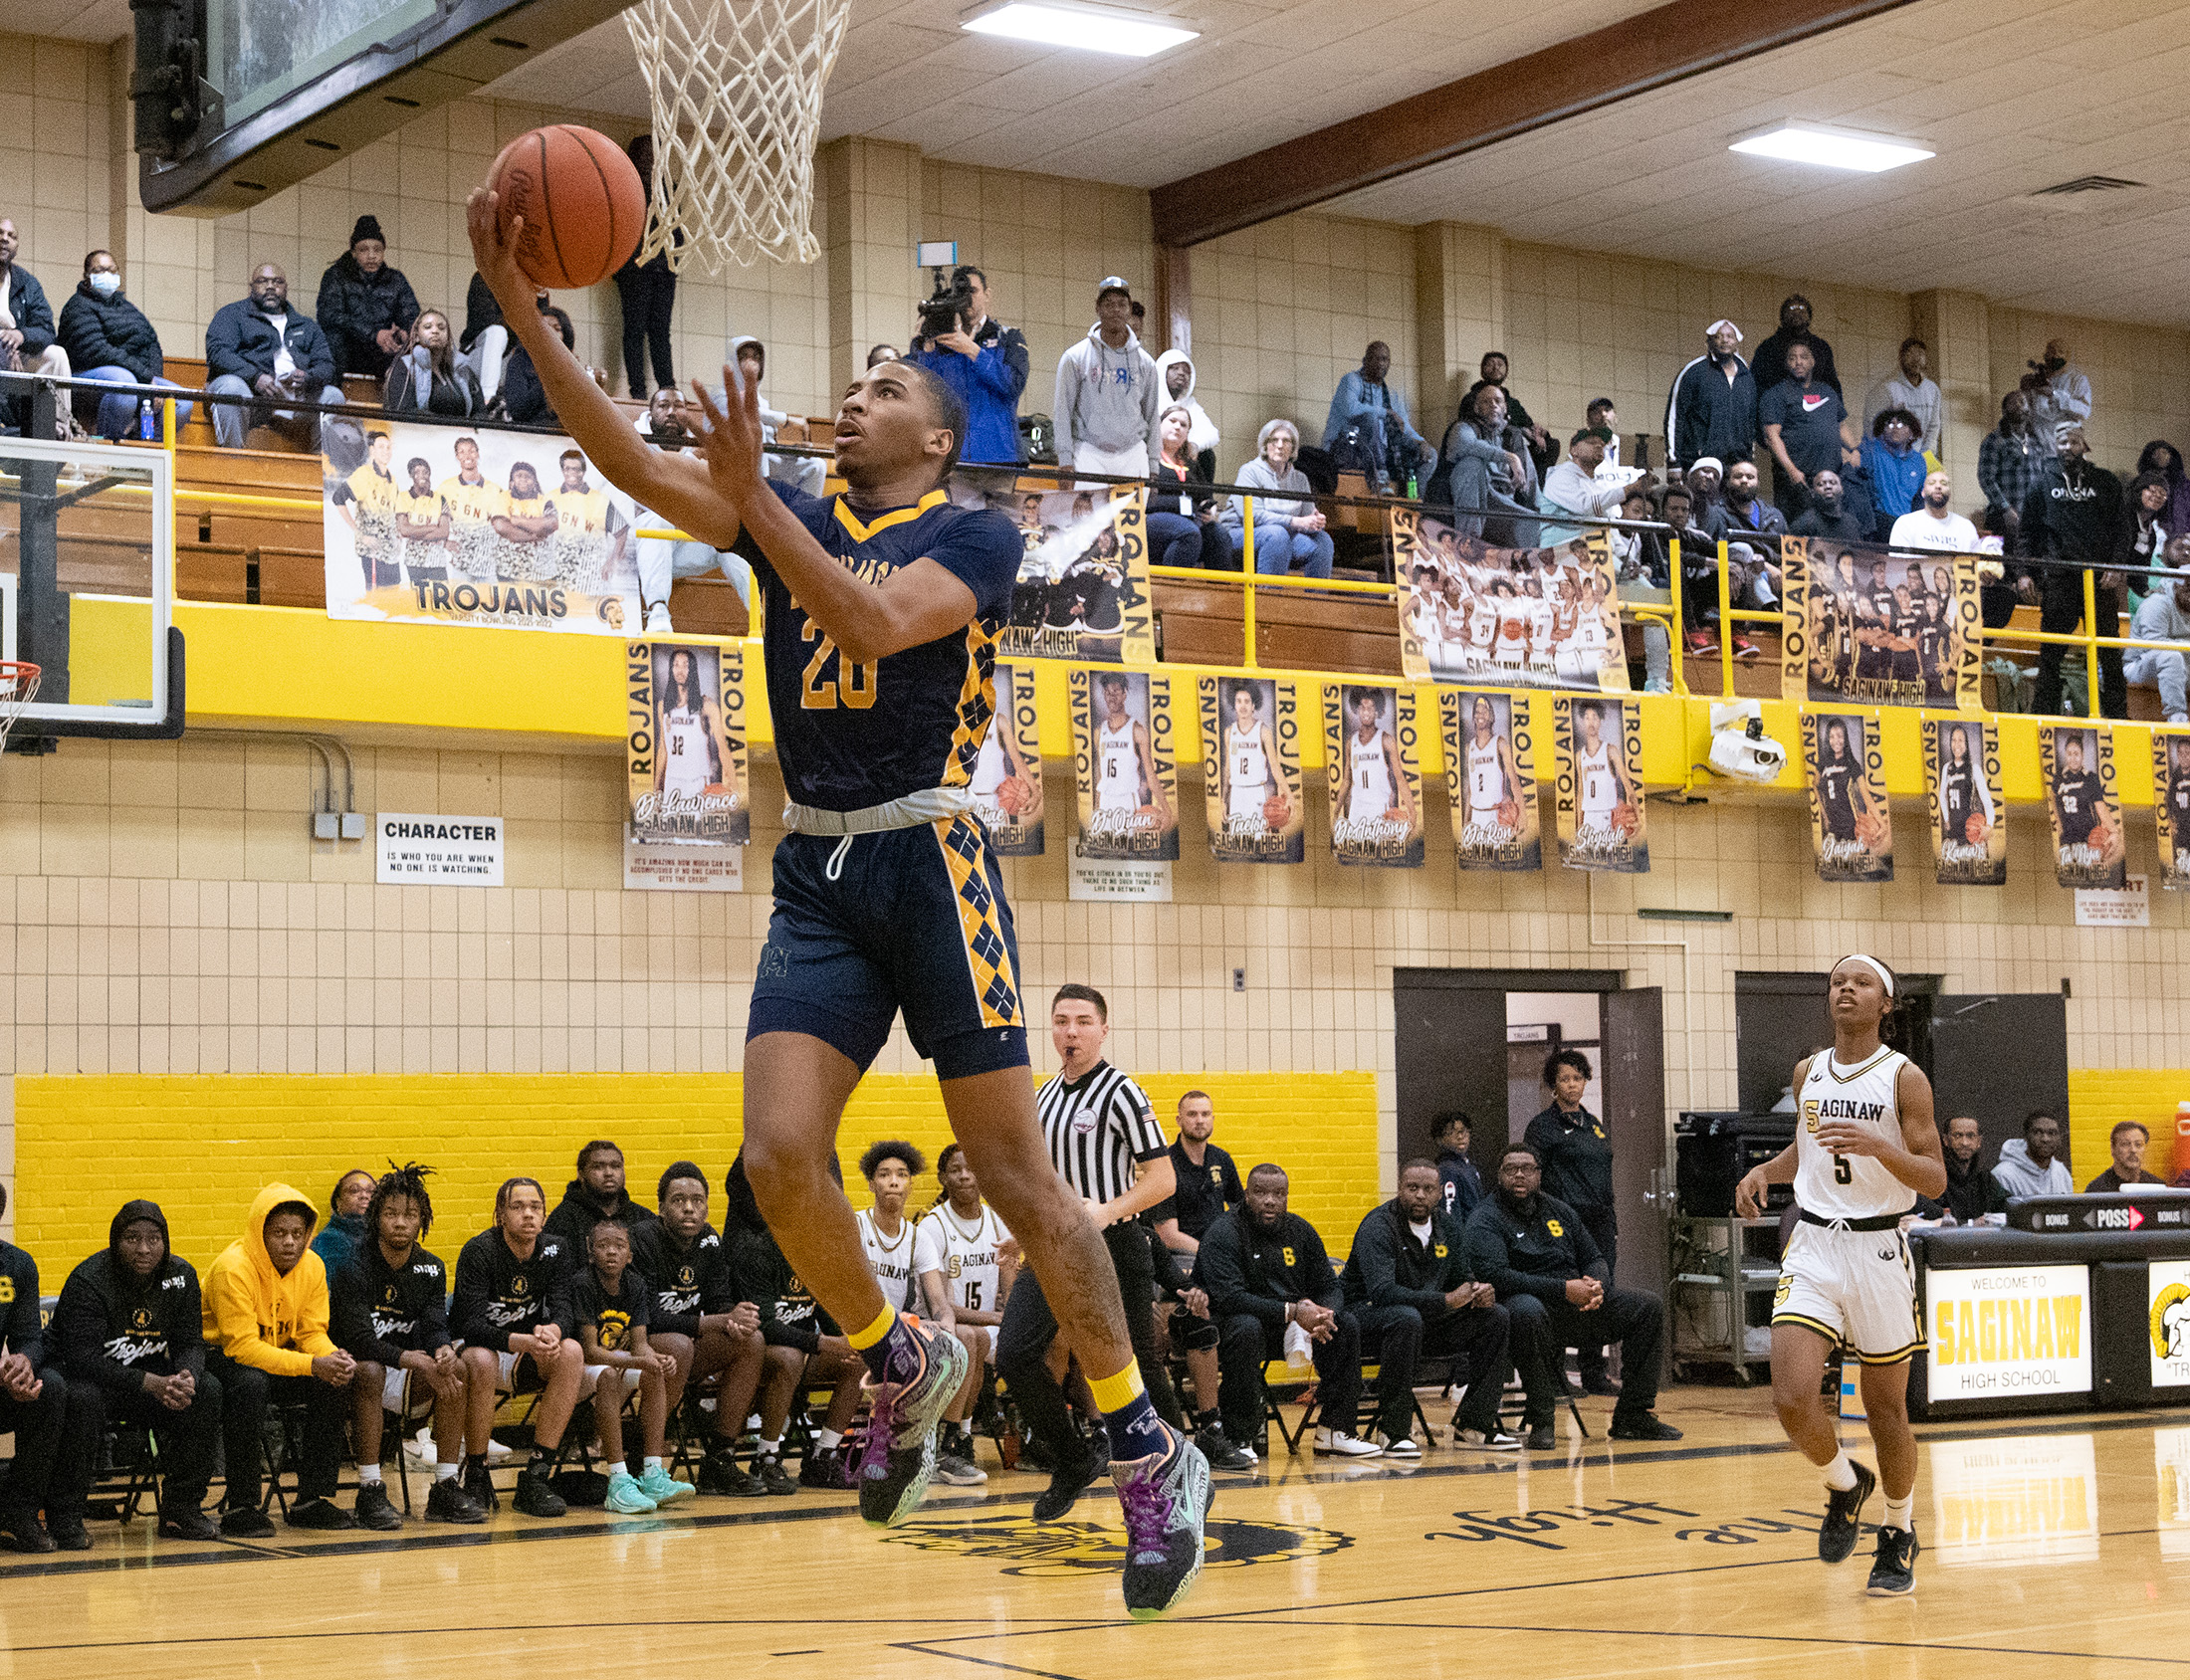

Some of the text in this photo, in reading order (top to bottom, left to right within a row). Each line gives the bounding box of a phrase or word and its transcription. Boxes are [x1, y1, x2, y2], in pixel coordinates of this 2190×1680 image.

[410, 579, 568, 619] TROJANS
[800, 617, 878, 710] 20
[671, 735, 684, 756] 32
[1106, 757, 1118, 778] 15
[1239, 757, 1249, 775] 12
[1361, 769, 1370, 789] 11
[384, 821, 497, 842] CHARACTER
[702, 812, 731, 834] HIGH
[997, 824, 1025, 844] HIGH
[1133, 829, 1161, 851] HIGH
[1260, 833, 1286, 853] HIGH
[400, 852, 421, 861] WHO
[425, 853, 443, 862] YOU
[447, 854, 464, 863] ARE
[468, 855, 495, 864] WHEN
[1382, 839, 1407, 859] HIGH
[1499, 842, 1524, 862] HIGH
[1612, 845, 1634, 864] HIGH
[389, 863, 403, 872] NO
[406, 864, 424, 873] ONE
[442, 865, 493, 875] WATCHING.
[1804, 1099, 1886, 1133] SAGINAW
[1833, 1144, 1853, 1185] 5
[2045, 1208, 2181, 1228] BONUS POSS BONUS
[1971, 1275, 2047, 1291] WELCOME TO
[965, 1281, 983, 1311] 15
[1935, 1294, 2082, 1366] SAGINAW
[1961, 1368, 2061, 1390] HIGH SCHOOL
[1424, 1498, 1701, 1551] High
